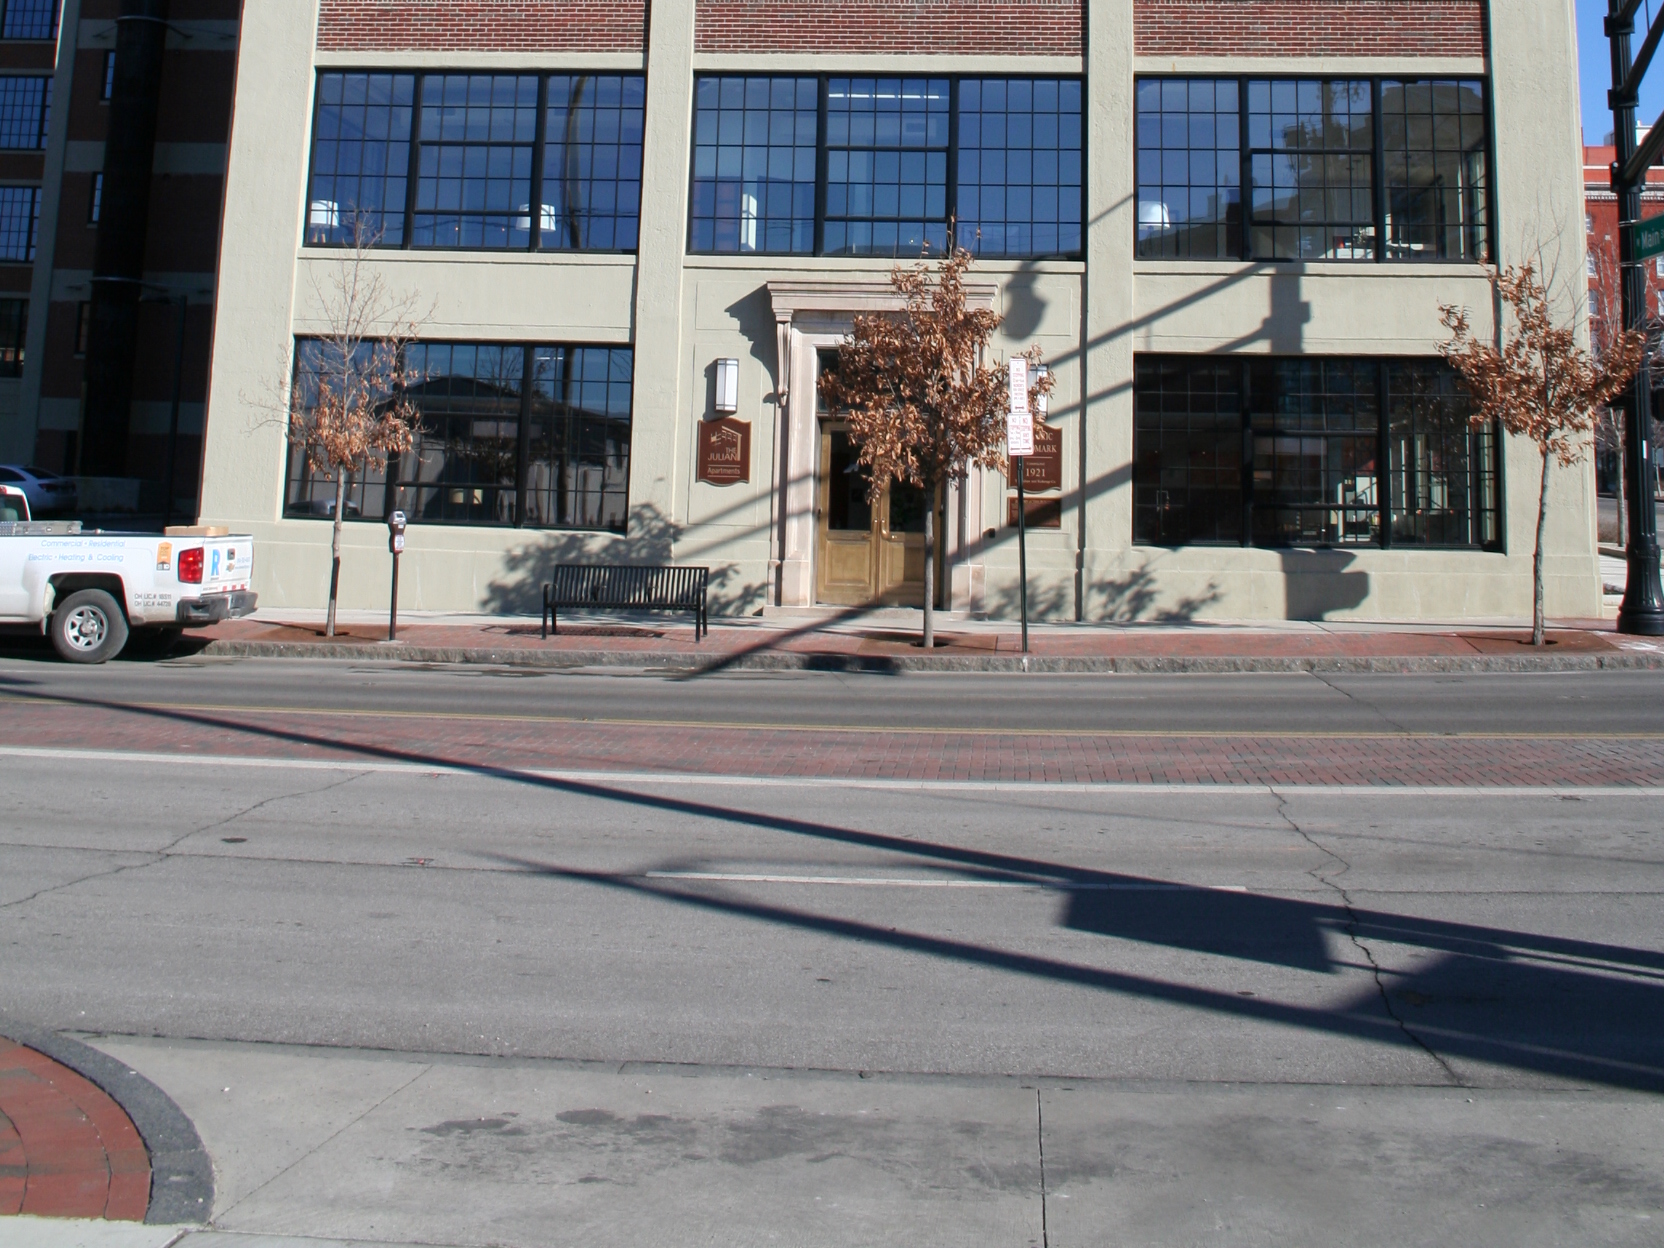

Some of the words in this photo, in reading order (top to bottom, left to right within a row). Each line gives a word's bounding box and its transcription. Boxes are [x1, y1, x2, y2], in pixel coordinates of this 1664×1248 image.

[1641, 228, 1660, 250] Main
[1034, 444, 1057, 453] MARK
[707, 453, 738, 461] JULIAN
[707, 467, 740, 475] Apartments
[1025, 468, 1046, 477] 1921
[40, 539, 83, 547] Commercial
[88, 539, 126, 547] Residential
[28, 553, 53, 561] Electric
[58, 553, 86, 562] Heating
[96, 553, 124, 562] Cooling
